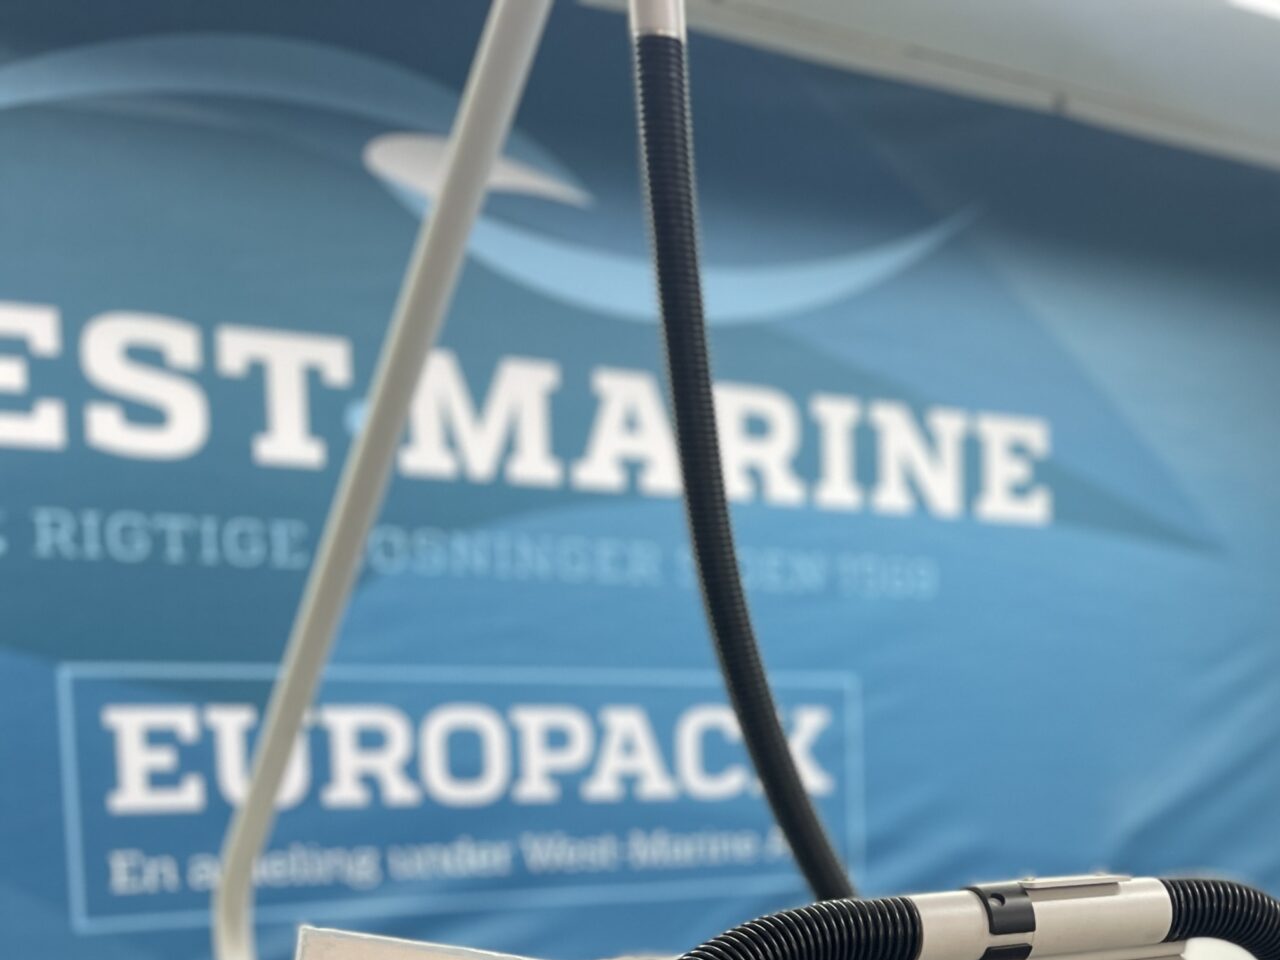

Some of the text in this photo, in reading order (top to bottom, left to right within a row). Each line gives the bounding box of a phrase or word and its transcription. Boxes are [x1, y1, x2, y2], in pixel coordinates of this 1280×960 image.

[396, 346, 1054, 526] MARINE
[108, 847, 179, 896] En
[626, 825, 757, 869] Marine
